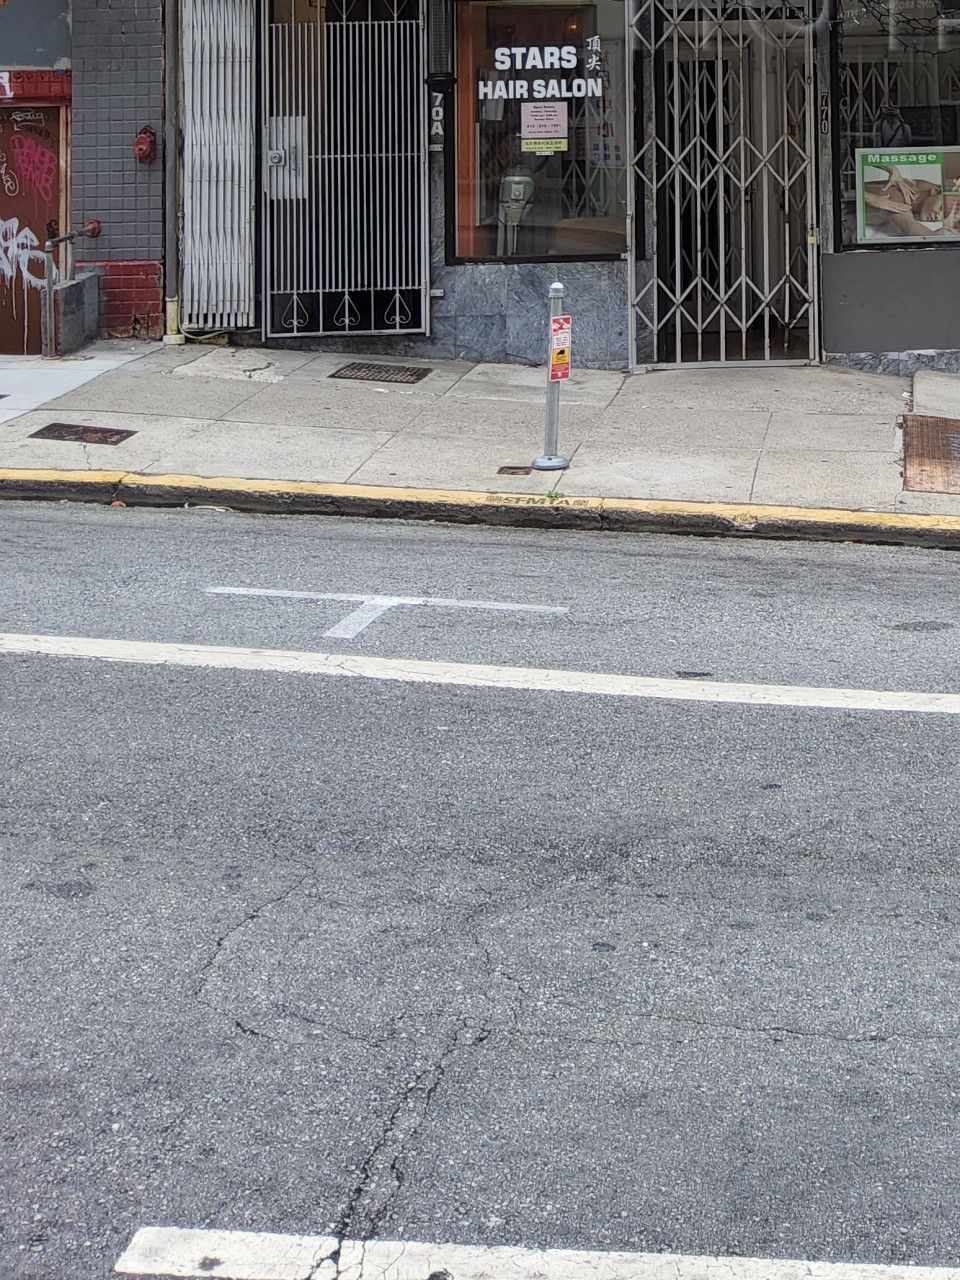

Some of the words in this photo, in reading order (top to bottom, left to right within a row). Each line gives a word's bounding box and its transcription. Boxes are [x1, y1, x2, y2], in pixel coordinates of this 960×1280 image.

[494, 45, 578, 71] STARS
[585, 35, 602, 71] 頂尖
[478, 79, 529, 101] HAIR
[532, 77, 603, 99] SALON
[867, 152, 937, 164] Massage
